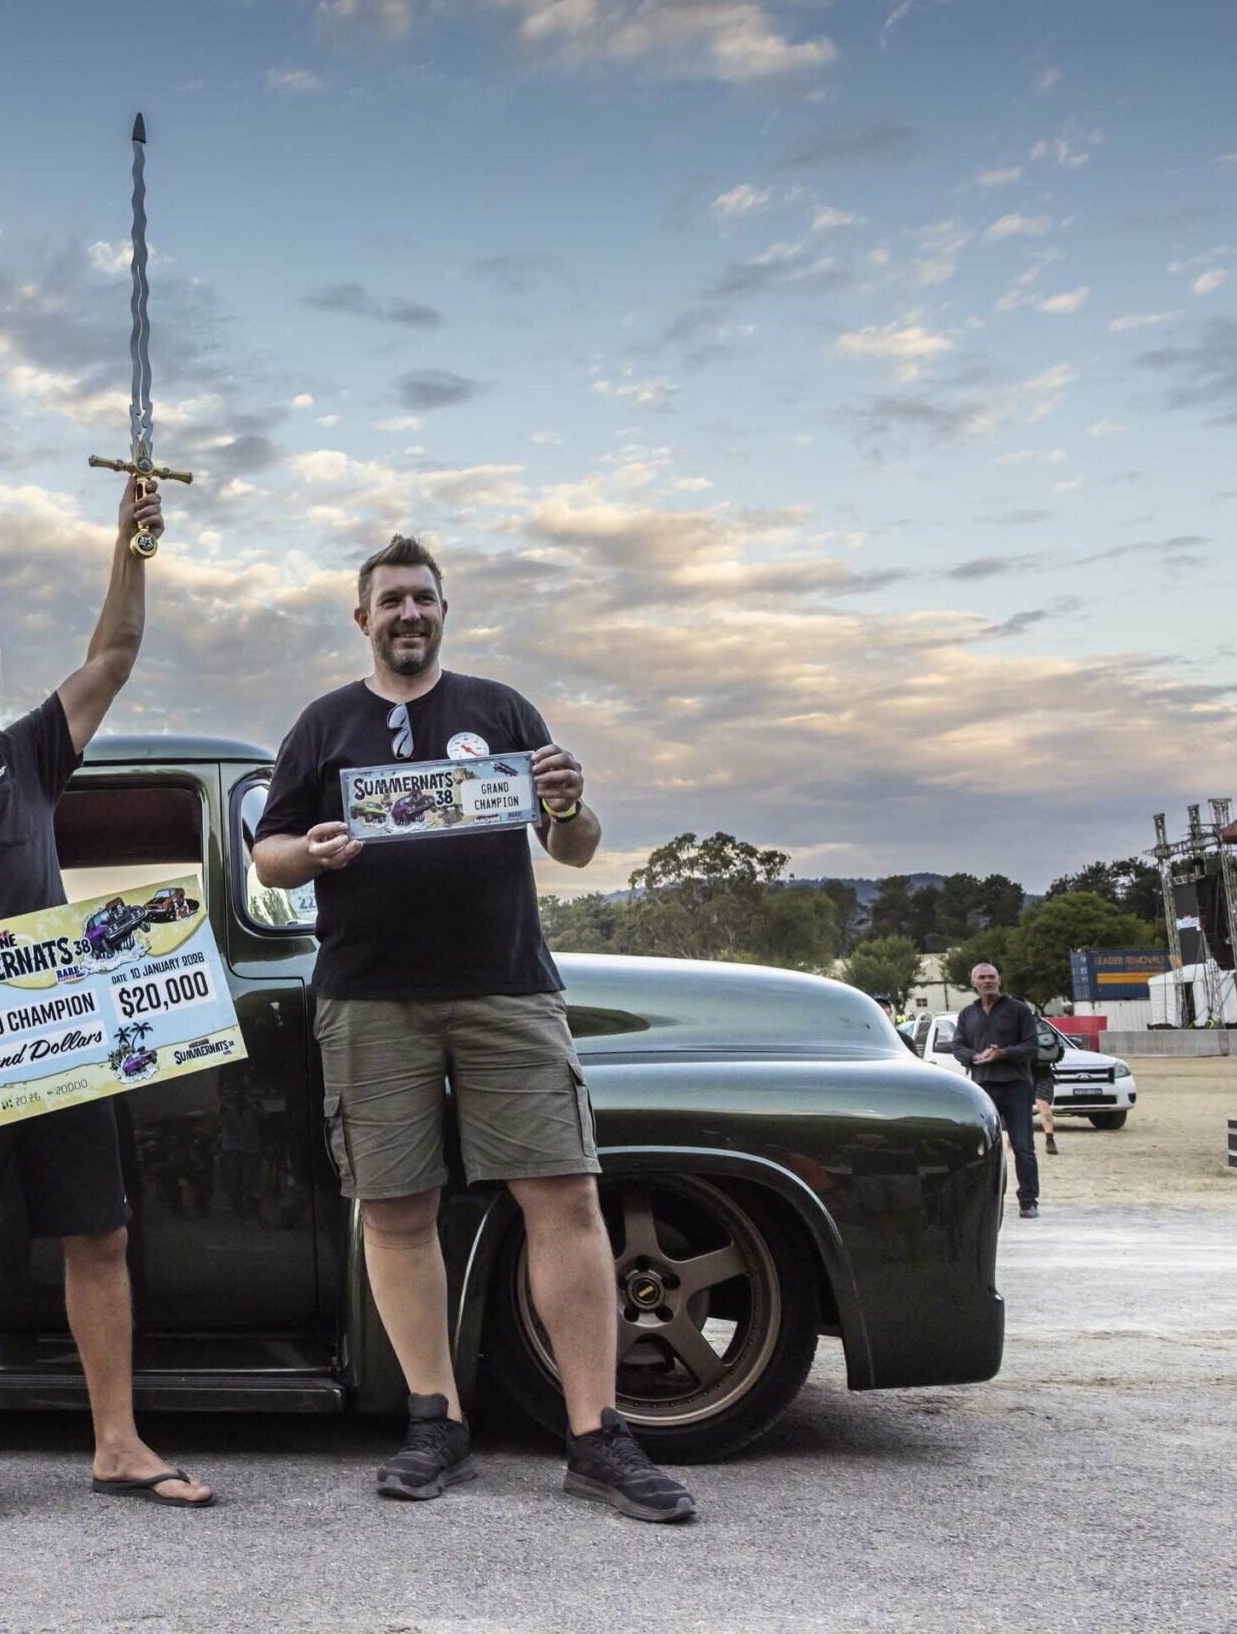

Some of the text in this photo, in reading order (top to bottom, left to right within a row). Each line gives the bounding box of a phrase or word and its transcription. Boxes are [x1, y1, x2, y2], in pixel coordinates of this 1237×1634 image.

[353, 771, 454, 800] SUMMERNATS
[435, 790, 454, 806] 38
[481, 781, 509, 794] GRAND
[474, 796, 519, 811] CHAMPION
[73, 939, 91, 957] 38
[111, 952, 205, 985] DATE 10 JANUARY 2026
[118, 970, 209, 1018] $20,000
[9, 992, 96, 1031] CHAMPION
[30, 1030, 103, 1060] Dollars
[173, 1039, 229, 1065] SUMMERNATS
